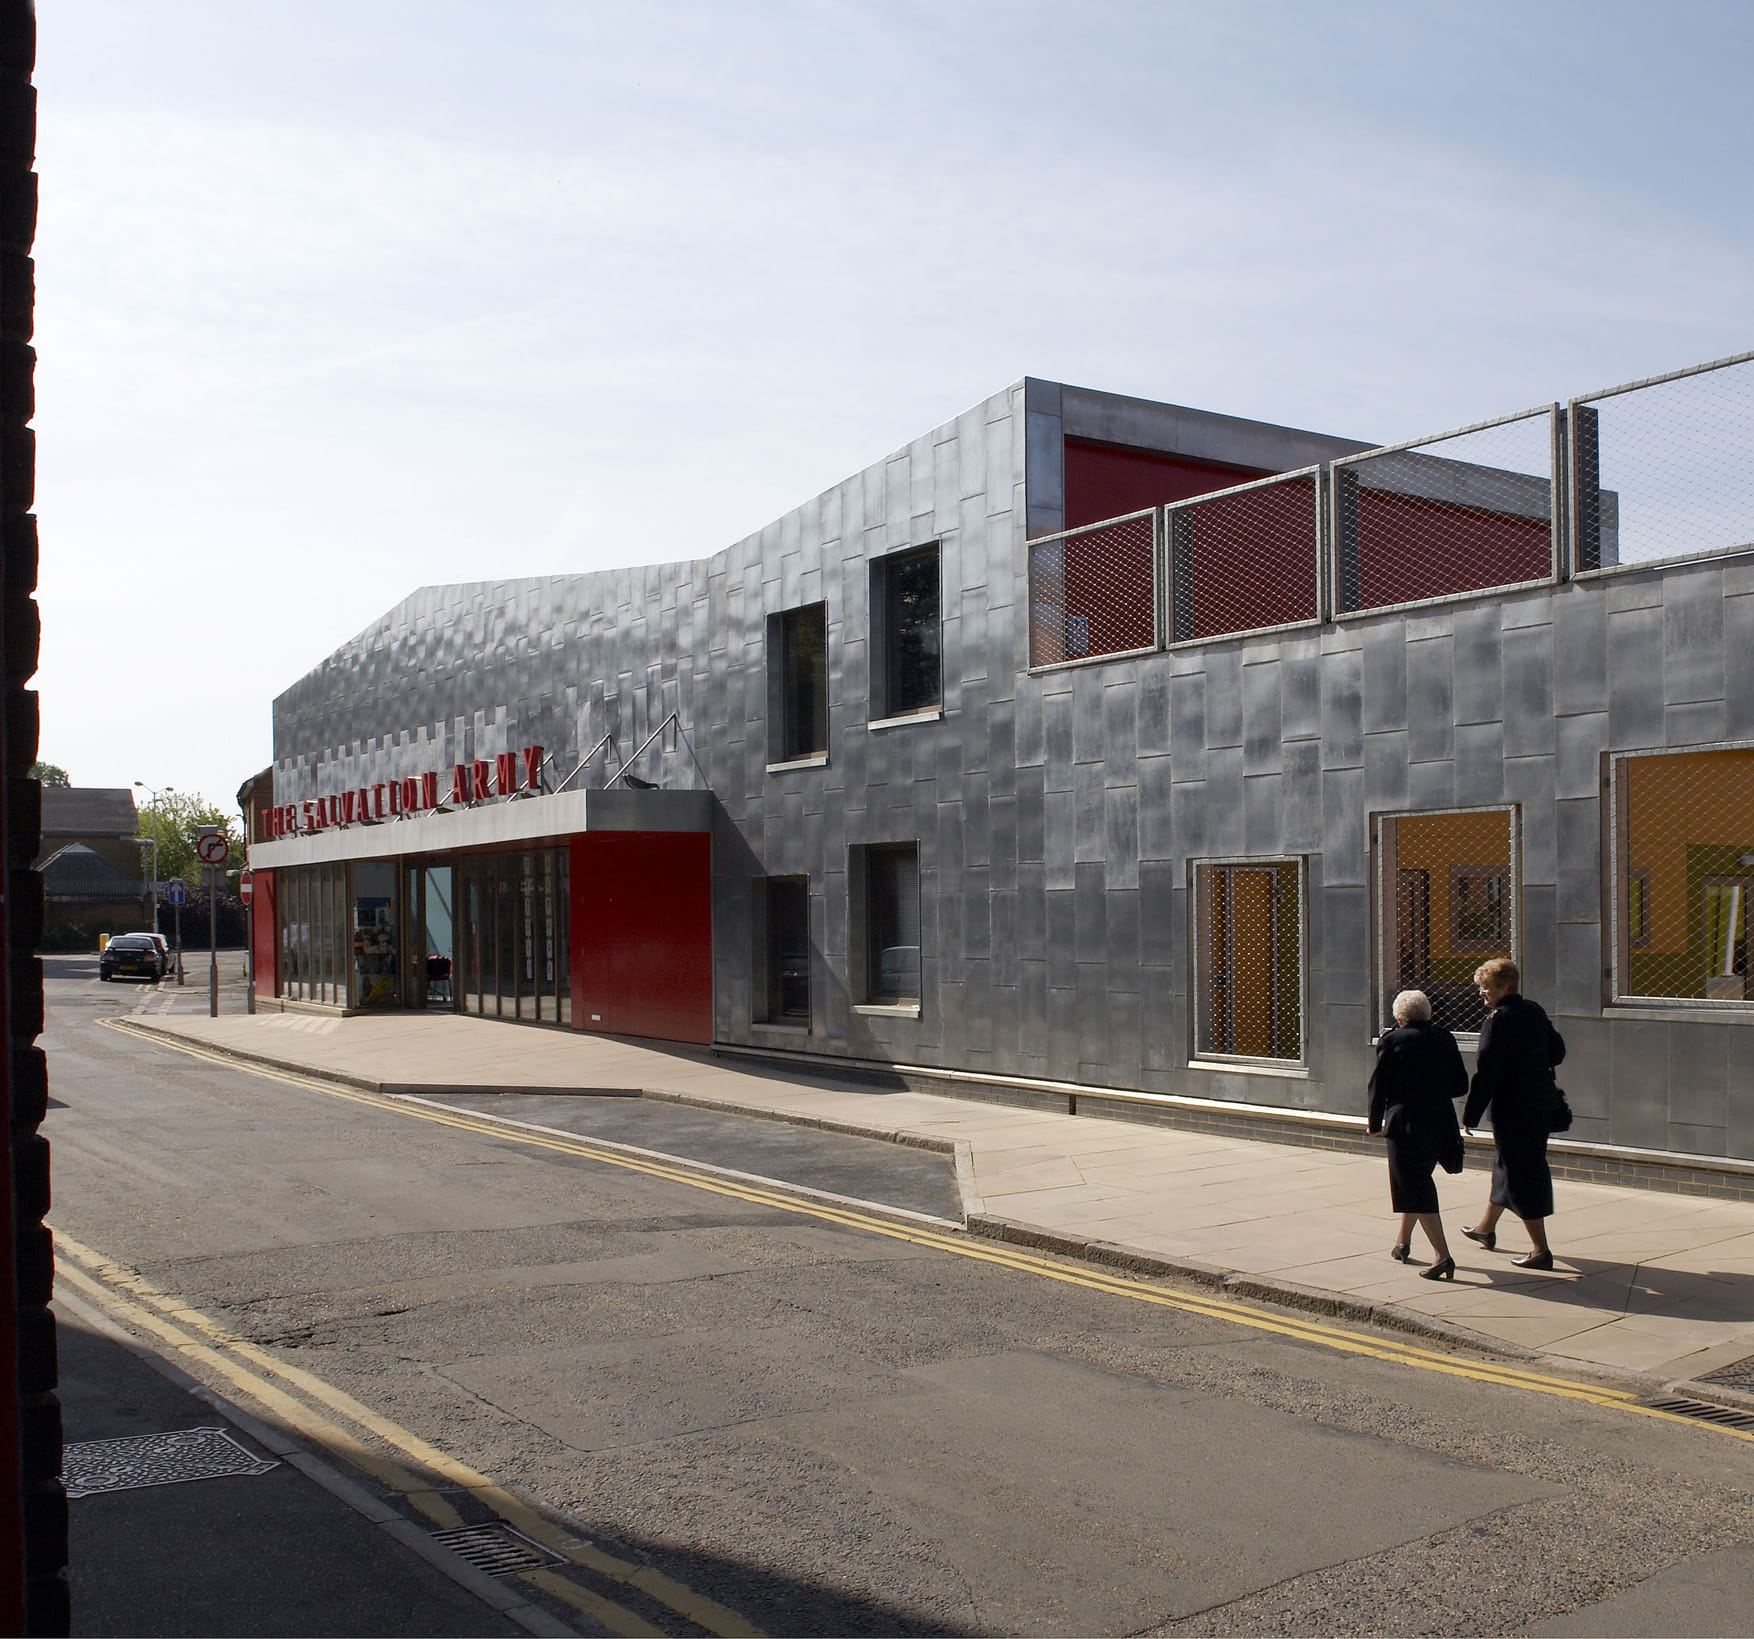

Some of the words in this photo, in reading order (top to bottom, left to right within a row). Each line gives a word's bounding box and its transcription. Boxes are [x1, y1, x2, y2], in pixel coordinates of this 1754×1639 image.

[261, 804, 297, 837] THE
[302, 772, 437, 831] SALVATION
[452, 745, 544, 804] ARMY
